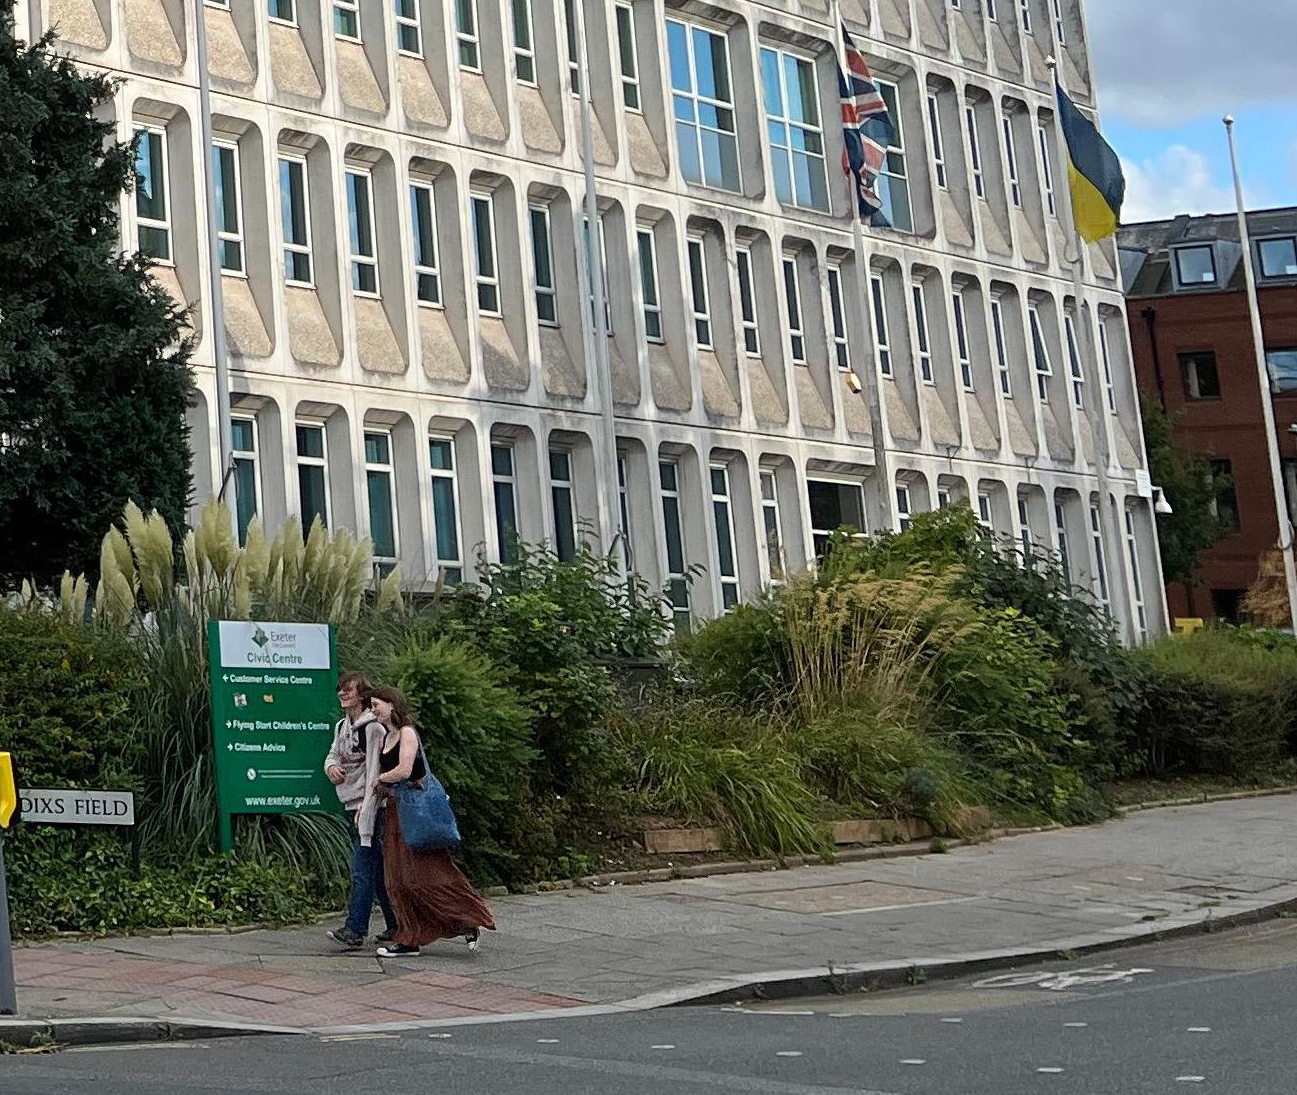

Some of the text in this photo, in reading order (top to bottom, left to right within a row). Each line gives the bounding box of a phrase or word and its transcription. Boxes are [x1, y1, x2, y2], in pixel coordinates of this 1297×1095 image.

[270, 631, 297, 642] Exeter
[247, 652, 303, 664] Civic Centre
[229, 674, 313, 685] Customer Service Centre
[233, 719, 330, 731] Flying Start Children's Centre
[234, 742, 286, 752] Citizens Advice
[20, 797, 128, 816] DIXS FIELD
[245, 795, 321, 808] www.exeter.gov.uk
